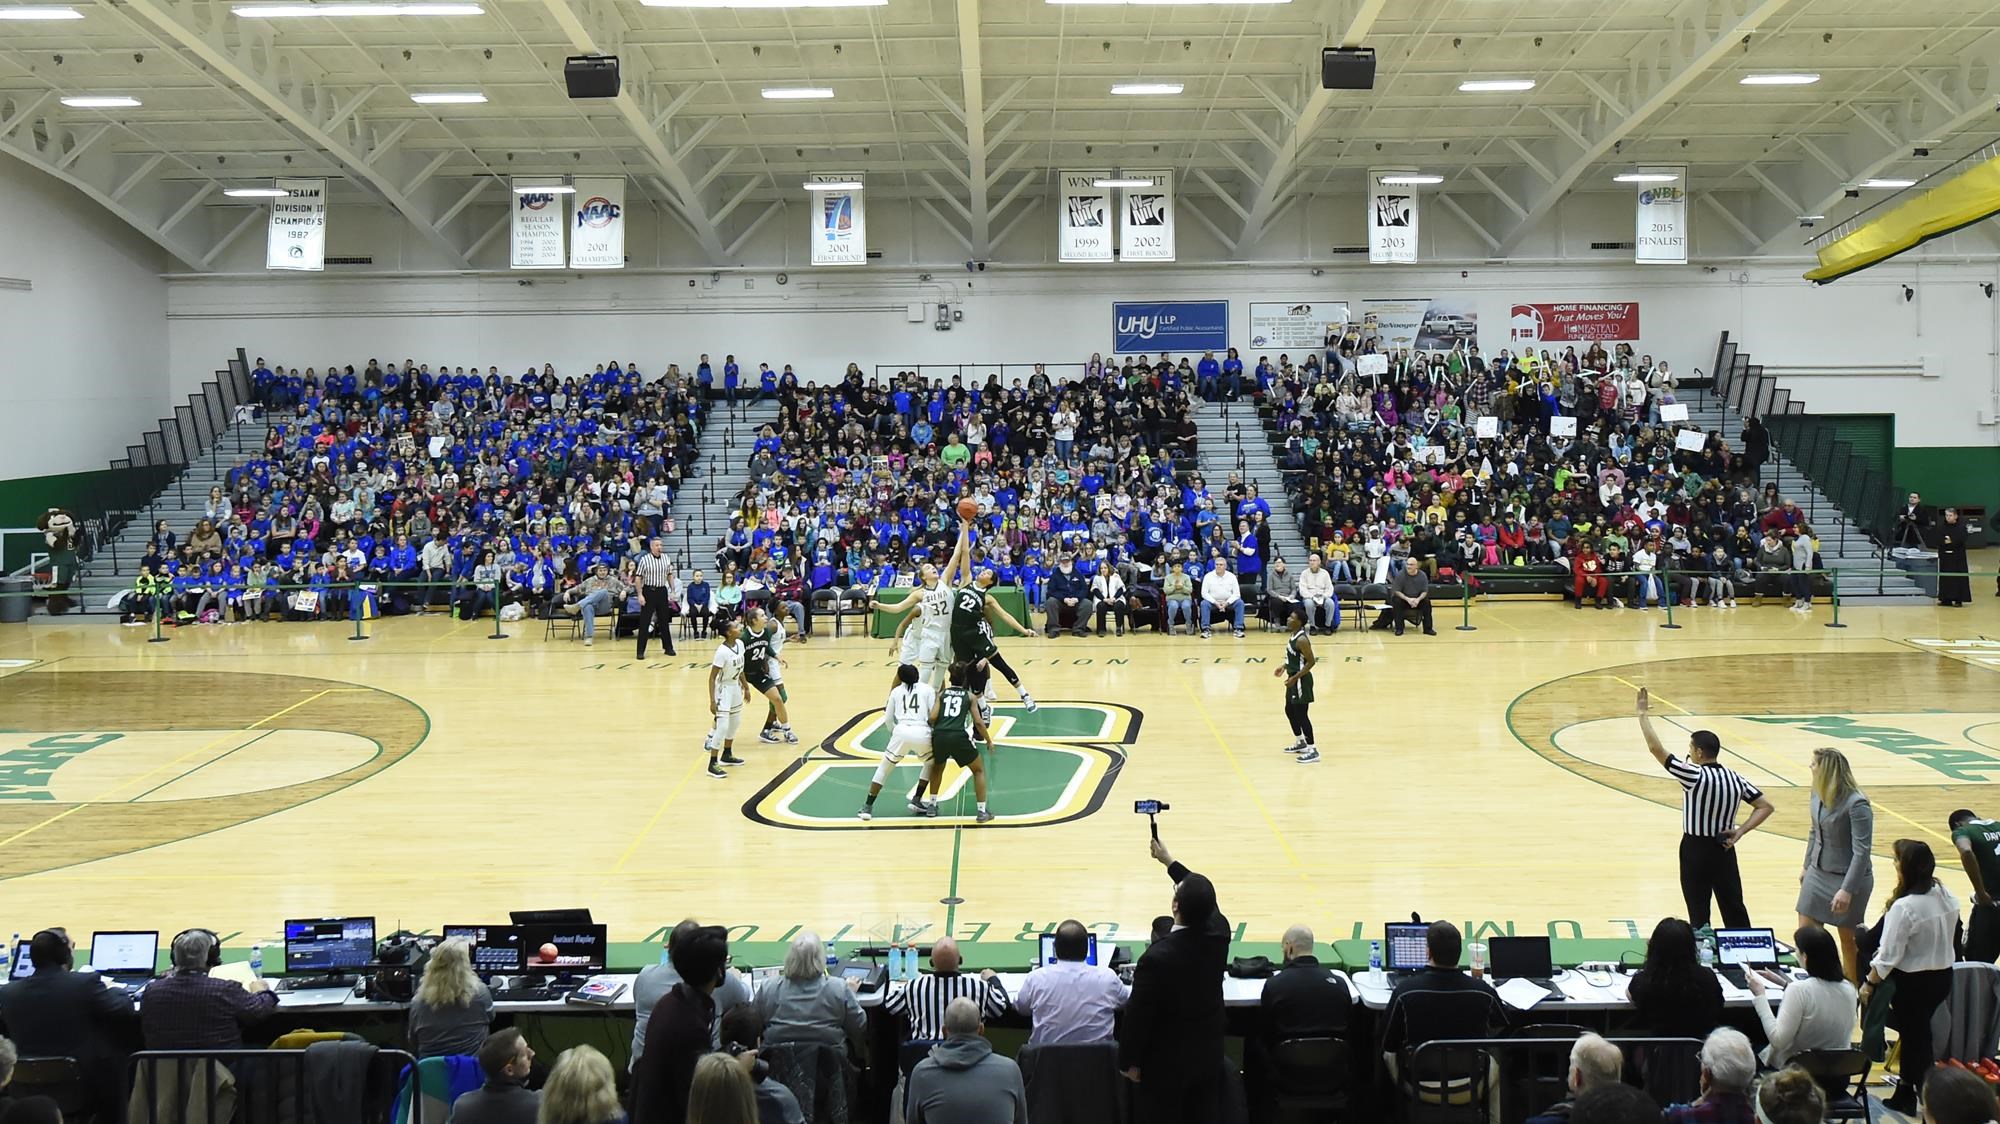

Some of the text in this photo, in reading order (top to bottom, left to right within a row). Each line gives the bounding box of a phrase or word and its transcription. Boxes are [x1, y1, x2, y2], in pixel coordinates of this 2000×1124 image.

[288, 189, 320, 198] YSAIAW
[275, 204, 312, 213] DIVISION
[577, 204, 621, 227] MAAC
[1651, 223, 1673, 232] 2015
[287, 231, 309, 239] 1987
[1074, 238, 1099, 248] 1999
[1134, 237, 1161, 247] 2002
[1381, 237, 1406, 249] 2003
[1639, 236, 1685, 246] FINALIST
[587, 243, 609, 252] 2001
[828, 244, 849, 253] 2001
[1160, 315, 1176, 324] LLP
[1553, 314, 1574, 322] That
[1576, 313, 1604, 321] Moves
[1118, 315, 1158, 339] UHY
[932, 601, 949, 615] 32
[960, 594, 976, 612] 22
[752, 647, 766, 660] 24
[1181, 655, 1364, 664] CENER
[903, 693, 919, 714] 14
[943, 696, 963, 717] 13
